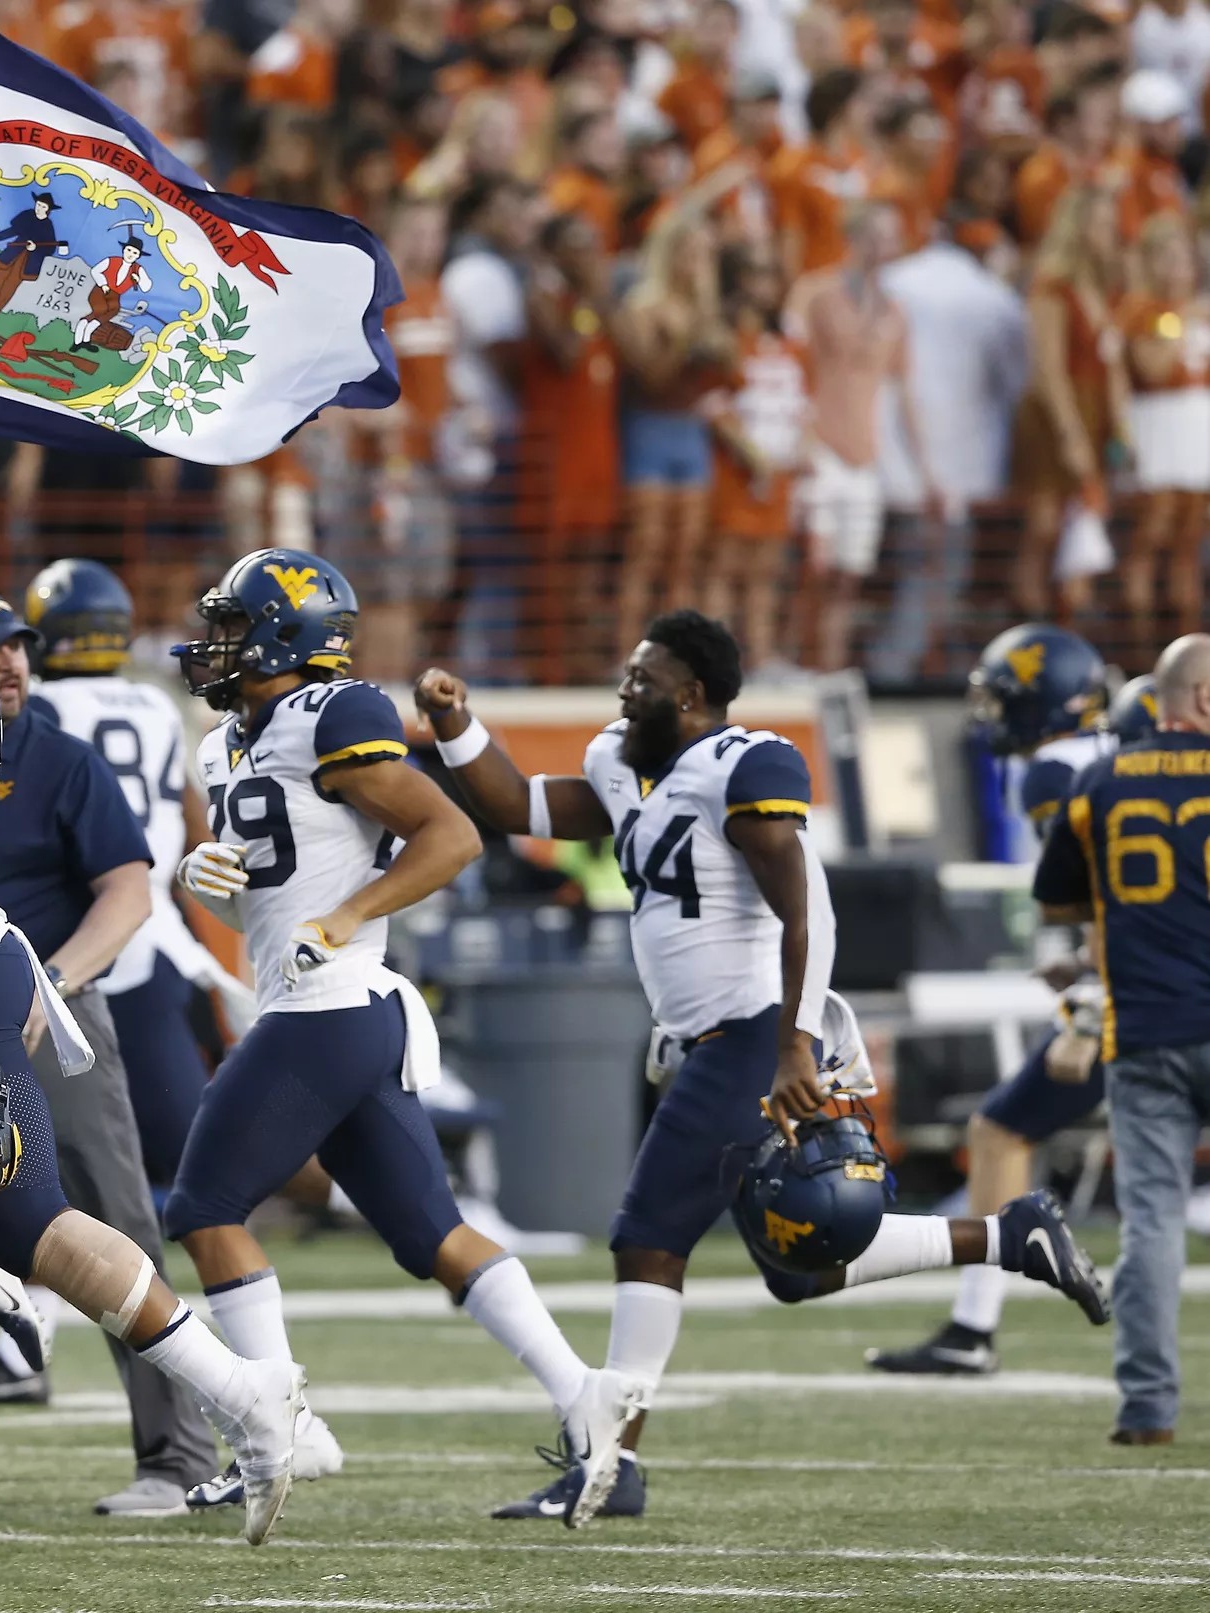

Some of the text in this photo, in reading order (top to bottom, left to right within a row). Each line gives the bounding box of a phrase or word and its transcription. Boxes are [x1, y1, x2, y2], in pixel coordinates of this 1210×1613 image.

[50, 135, 82, 155] OF
[91, 145, 157, 182] WEST
[155, 181, 236, 259] VIRGINIA
[36, 294, 72, 314] 1863
[46, 264, 87, 288] JUNE
[53, 281, 74, 298] 20
[93, 719, 185, 828] 84
[614, 808, 701, 919] 44
